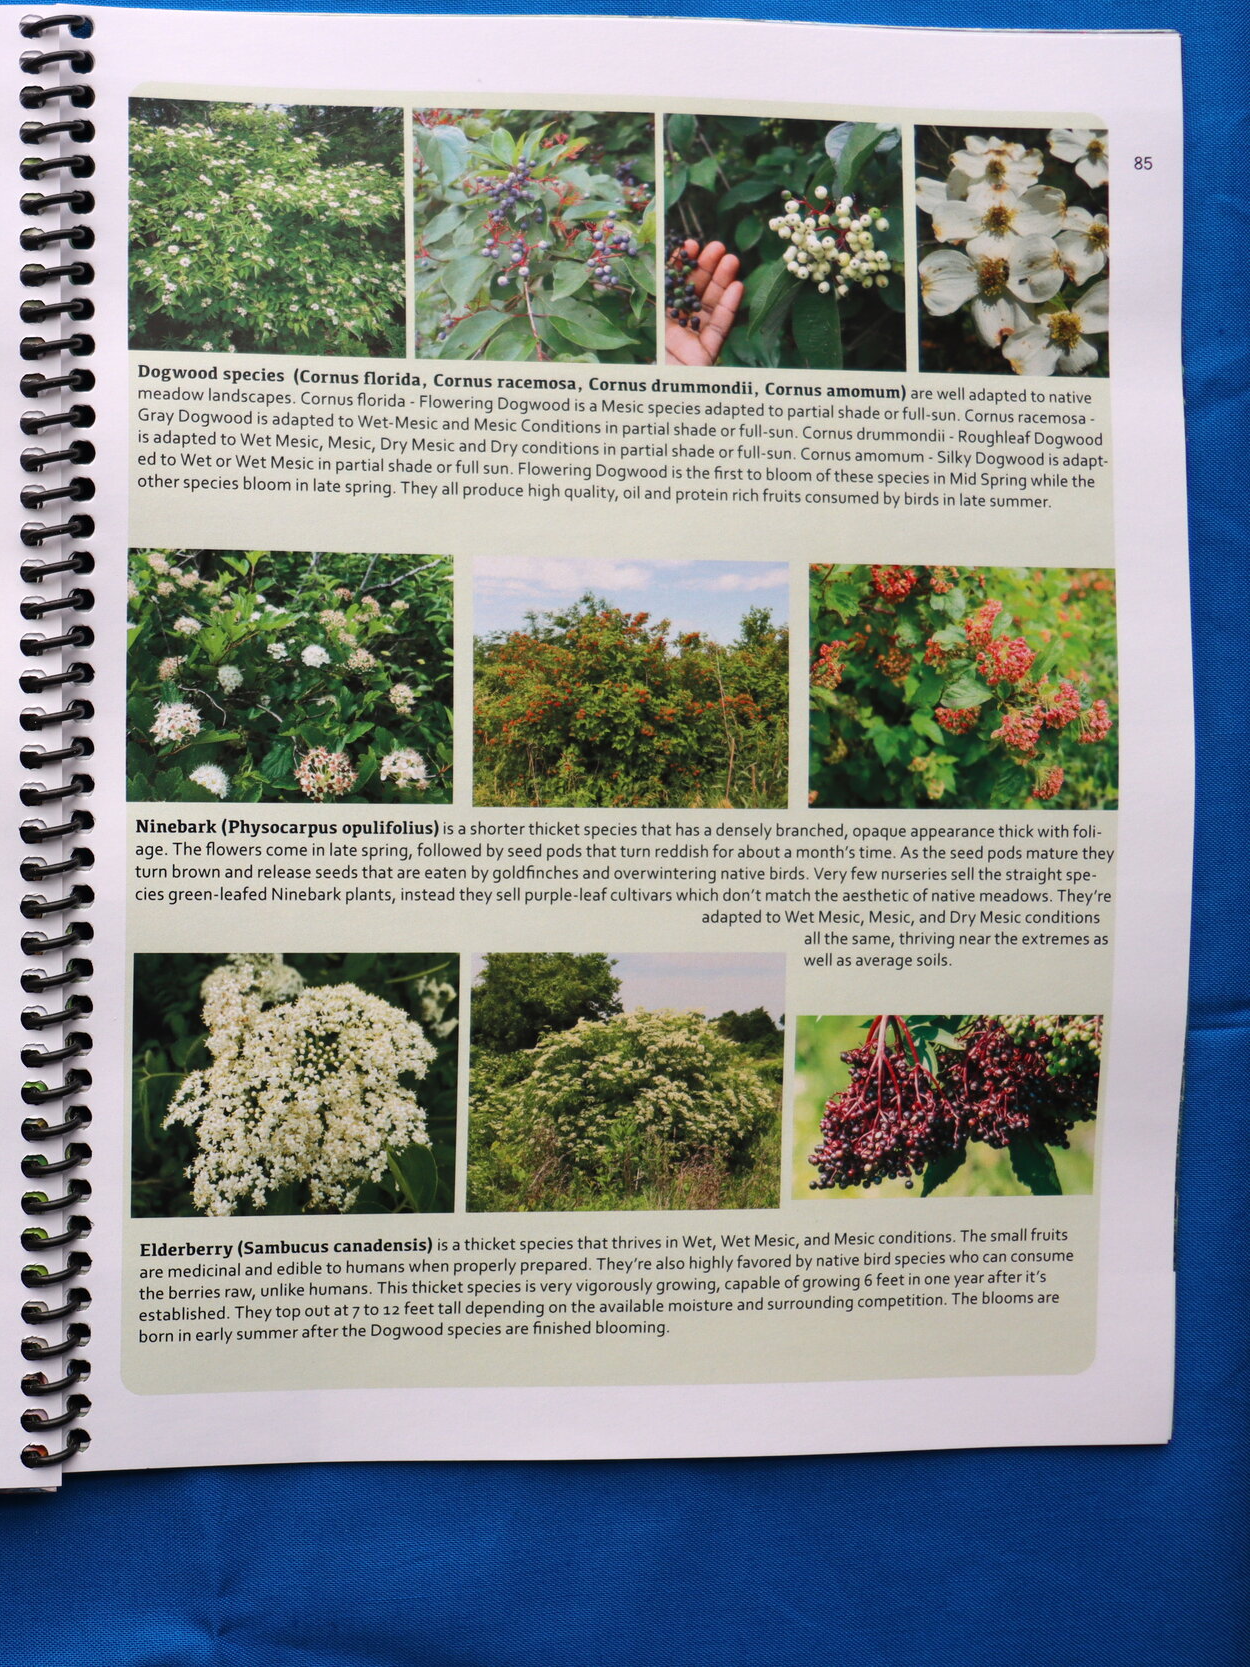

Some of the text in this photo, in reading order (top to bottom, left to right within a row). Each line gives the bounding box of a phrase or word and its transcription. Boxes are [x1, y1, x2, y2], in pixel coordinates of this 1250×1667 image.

[1133, 156, 1153, 171] 85
[136, 363, 1093, 406] Dogwood species (Cornus florida, Cornus racemosa, Cornus drummondii, Cornus amomum) are well adapted to native
[134, 817, 1103, 842] Ninebark (Physocarpus opulifolius) is a shorter thicket species that has a densely branched, opaque appearance thick with foli-
[803, 930, 1110, 950] all the same, thriving near the extremes as
[802, 951, 953, 972] well as average soils.
[139, 1226, 1069, 1260] Elderberry (Sambucus canadensis) is a thicket species that thrives in Wet, Wet Mesic, and Mesic conditions. The small fruits
[138, 1319, 671, 1346] born in early summer after the Dogwood species are finished blooming.
